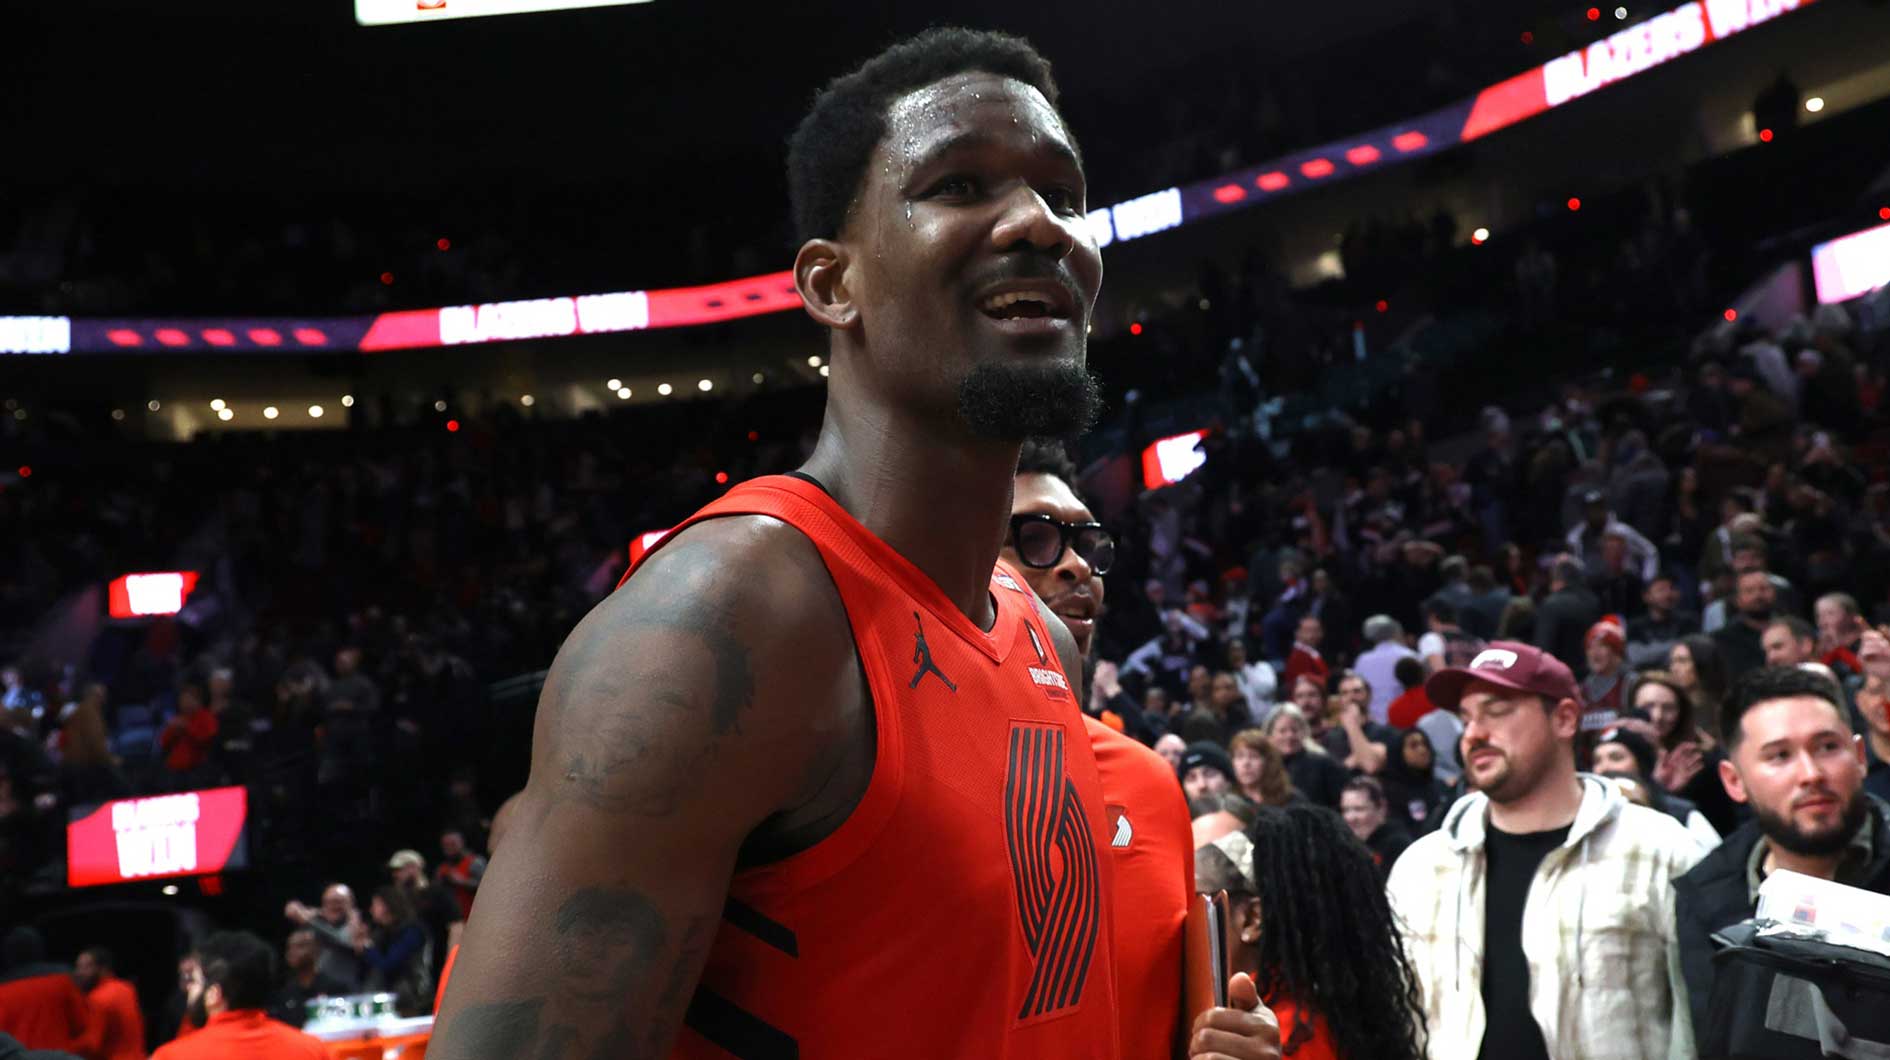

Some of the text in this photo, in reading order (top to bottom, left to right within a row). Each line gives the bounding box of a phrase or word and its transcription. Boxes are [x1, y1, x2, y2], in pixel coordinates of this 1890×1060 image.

[1543, 3, 1705, 106] BLAZERS
[440, 299, 575, 344] BLAZERS
[112, 792, 200, 832] BLAZERS
[116, 824, 198, 878] WIN
